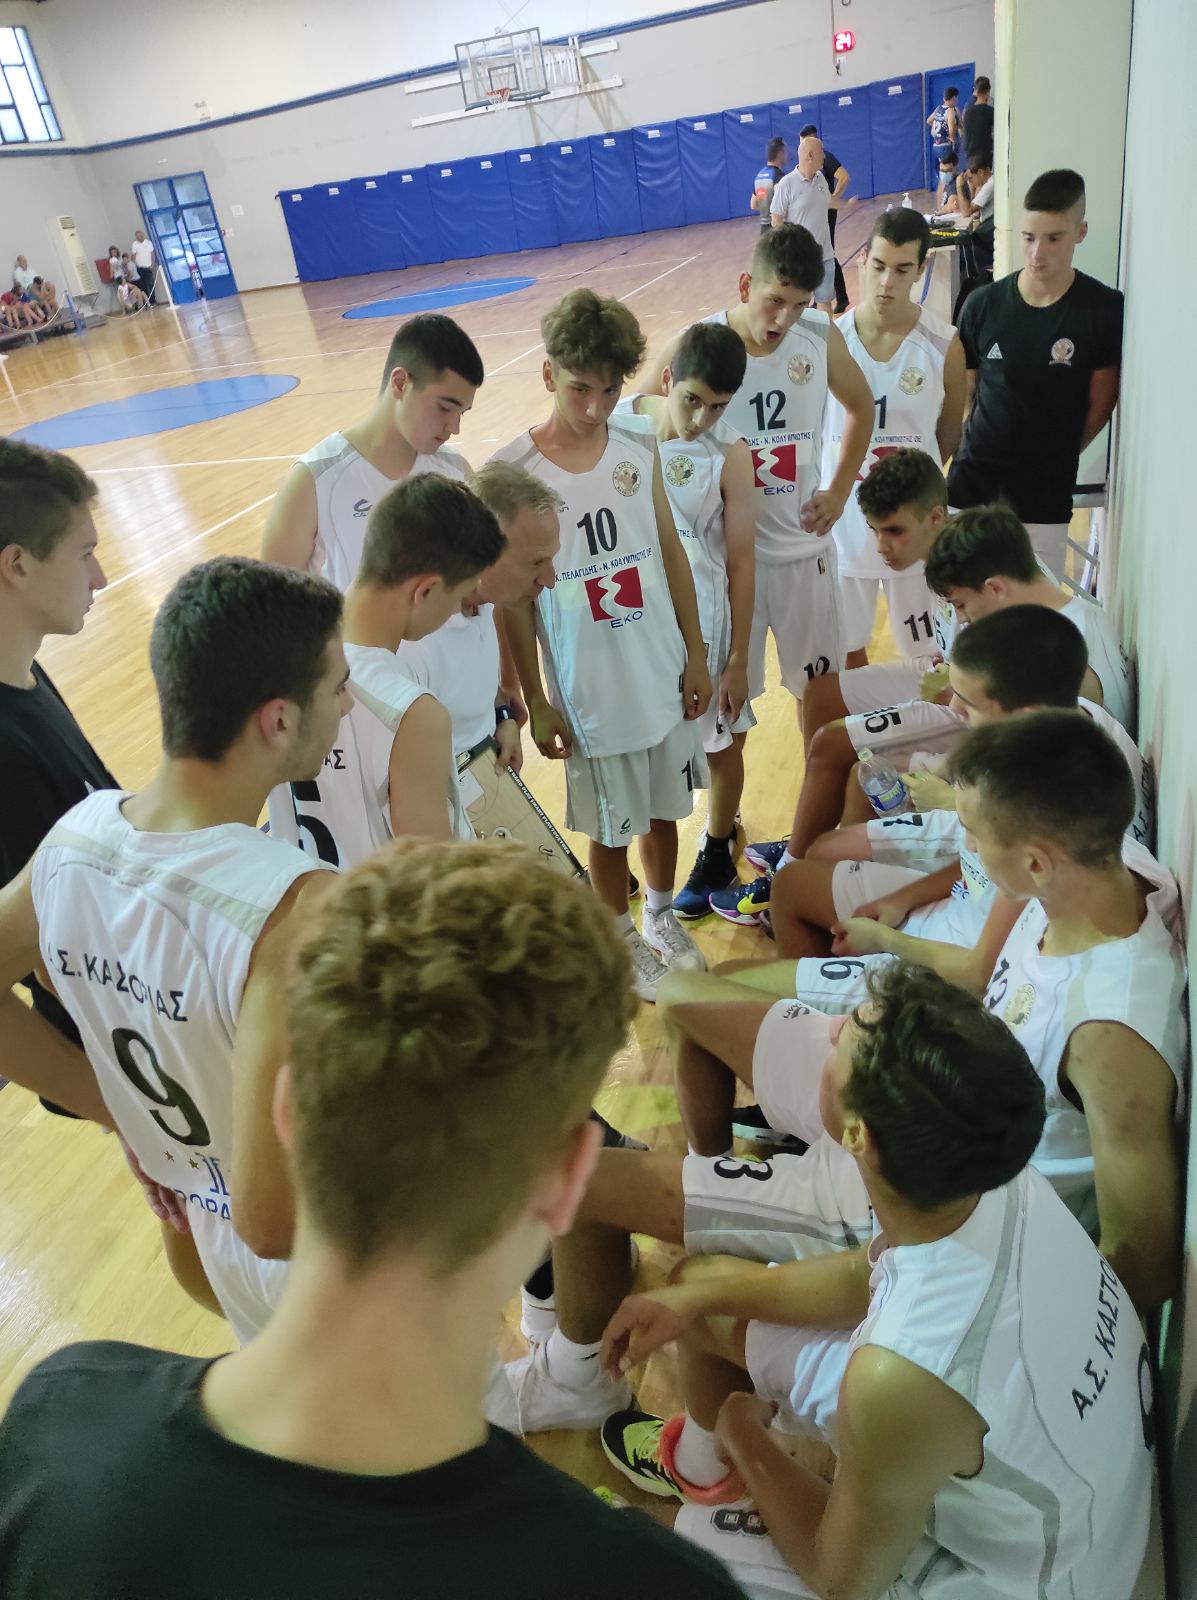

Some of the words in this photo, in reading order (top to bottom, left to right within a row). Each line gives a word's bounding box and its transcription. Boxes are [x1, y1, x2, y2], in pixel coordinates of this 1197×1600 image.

[835, 32, 852, 50] 24
[749, 389, 787, 430] 12
[576, 507, 618, 556] 10
[904, 610, 934, 642] 11
[521, 786, 533, 800] PLAY
[530, 799, 544, 817] SMART
[542, 813, 553, 829] PLAY
[111, 1026, 211, 1147] 9
[1071, 1358, 1109, 1421] Α.Σ.
